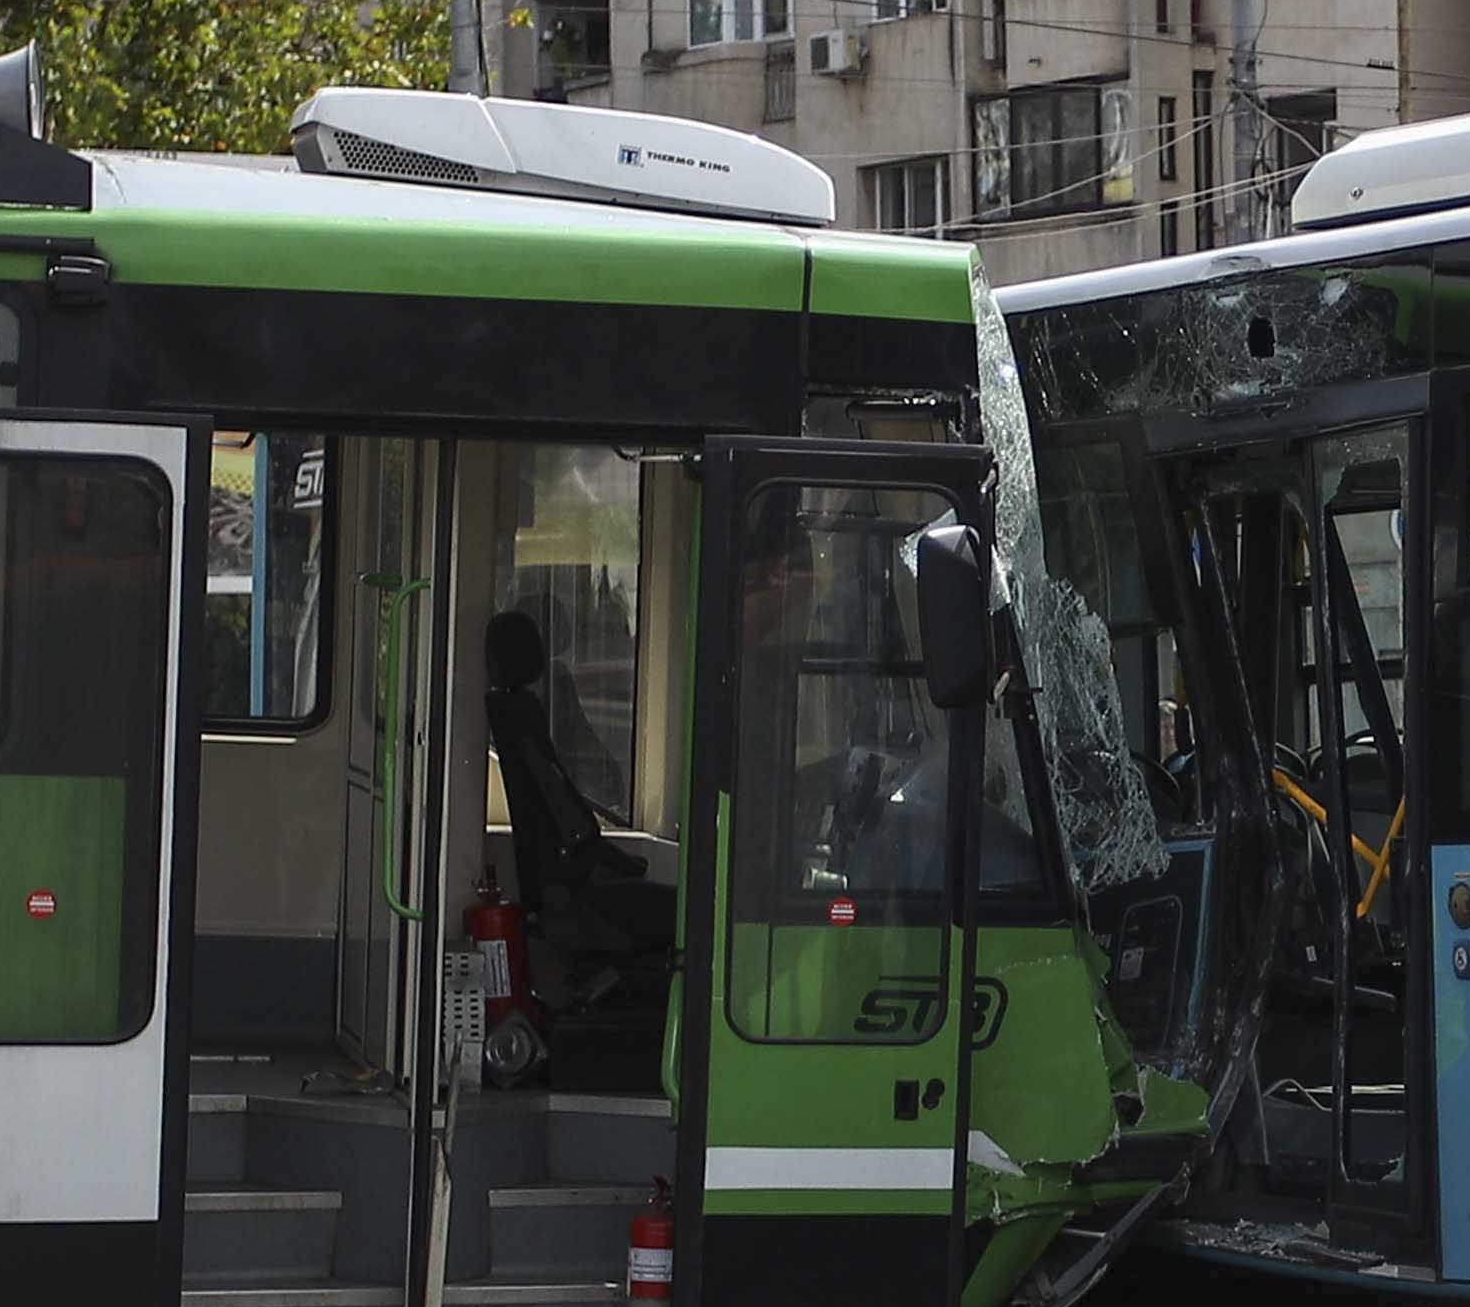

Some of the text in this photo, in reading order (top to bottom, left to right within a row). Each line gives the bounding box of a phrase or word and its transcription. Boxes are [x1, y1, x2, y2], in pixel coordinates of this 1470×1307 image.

[646, 151, 731, 173] THERMO KING
[294, 460, 324, 500] ST
